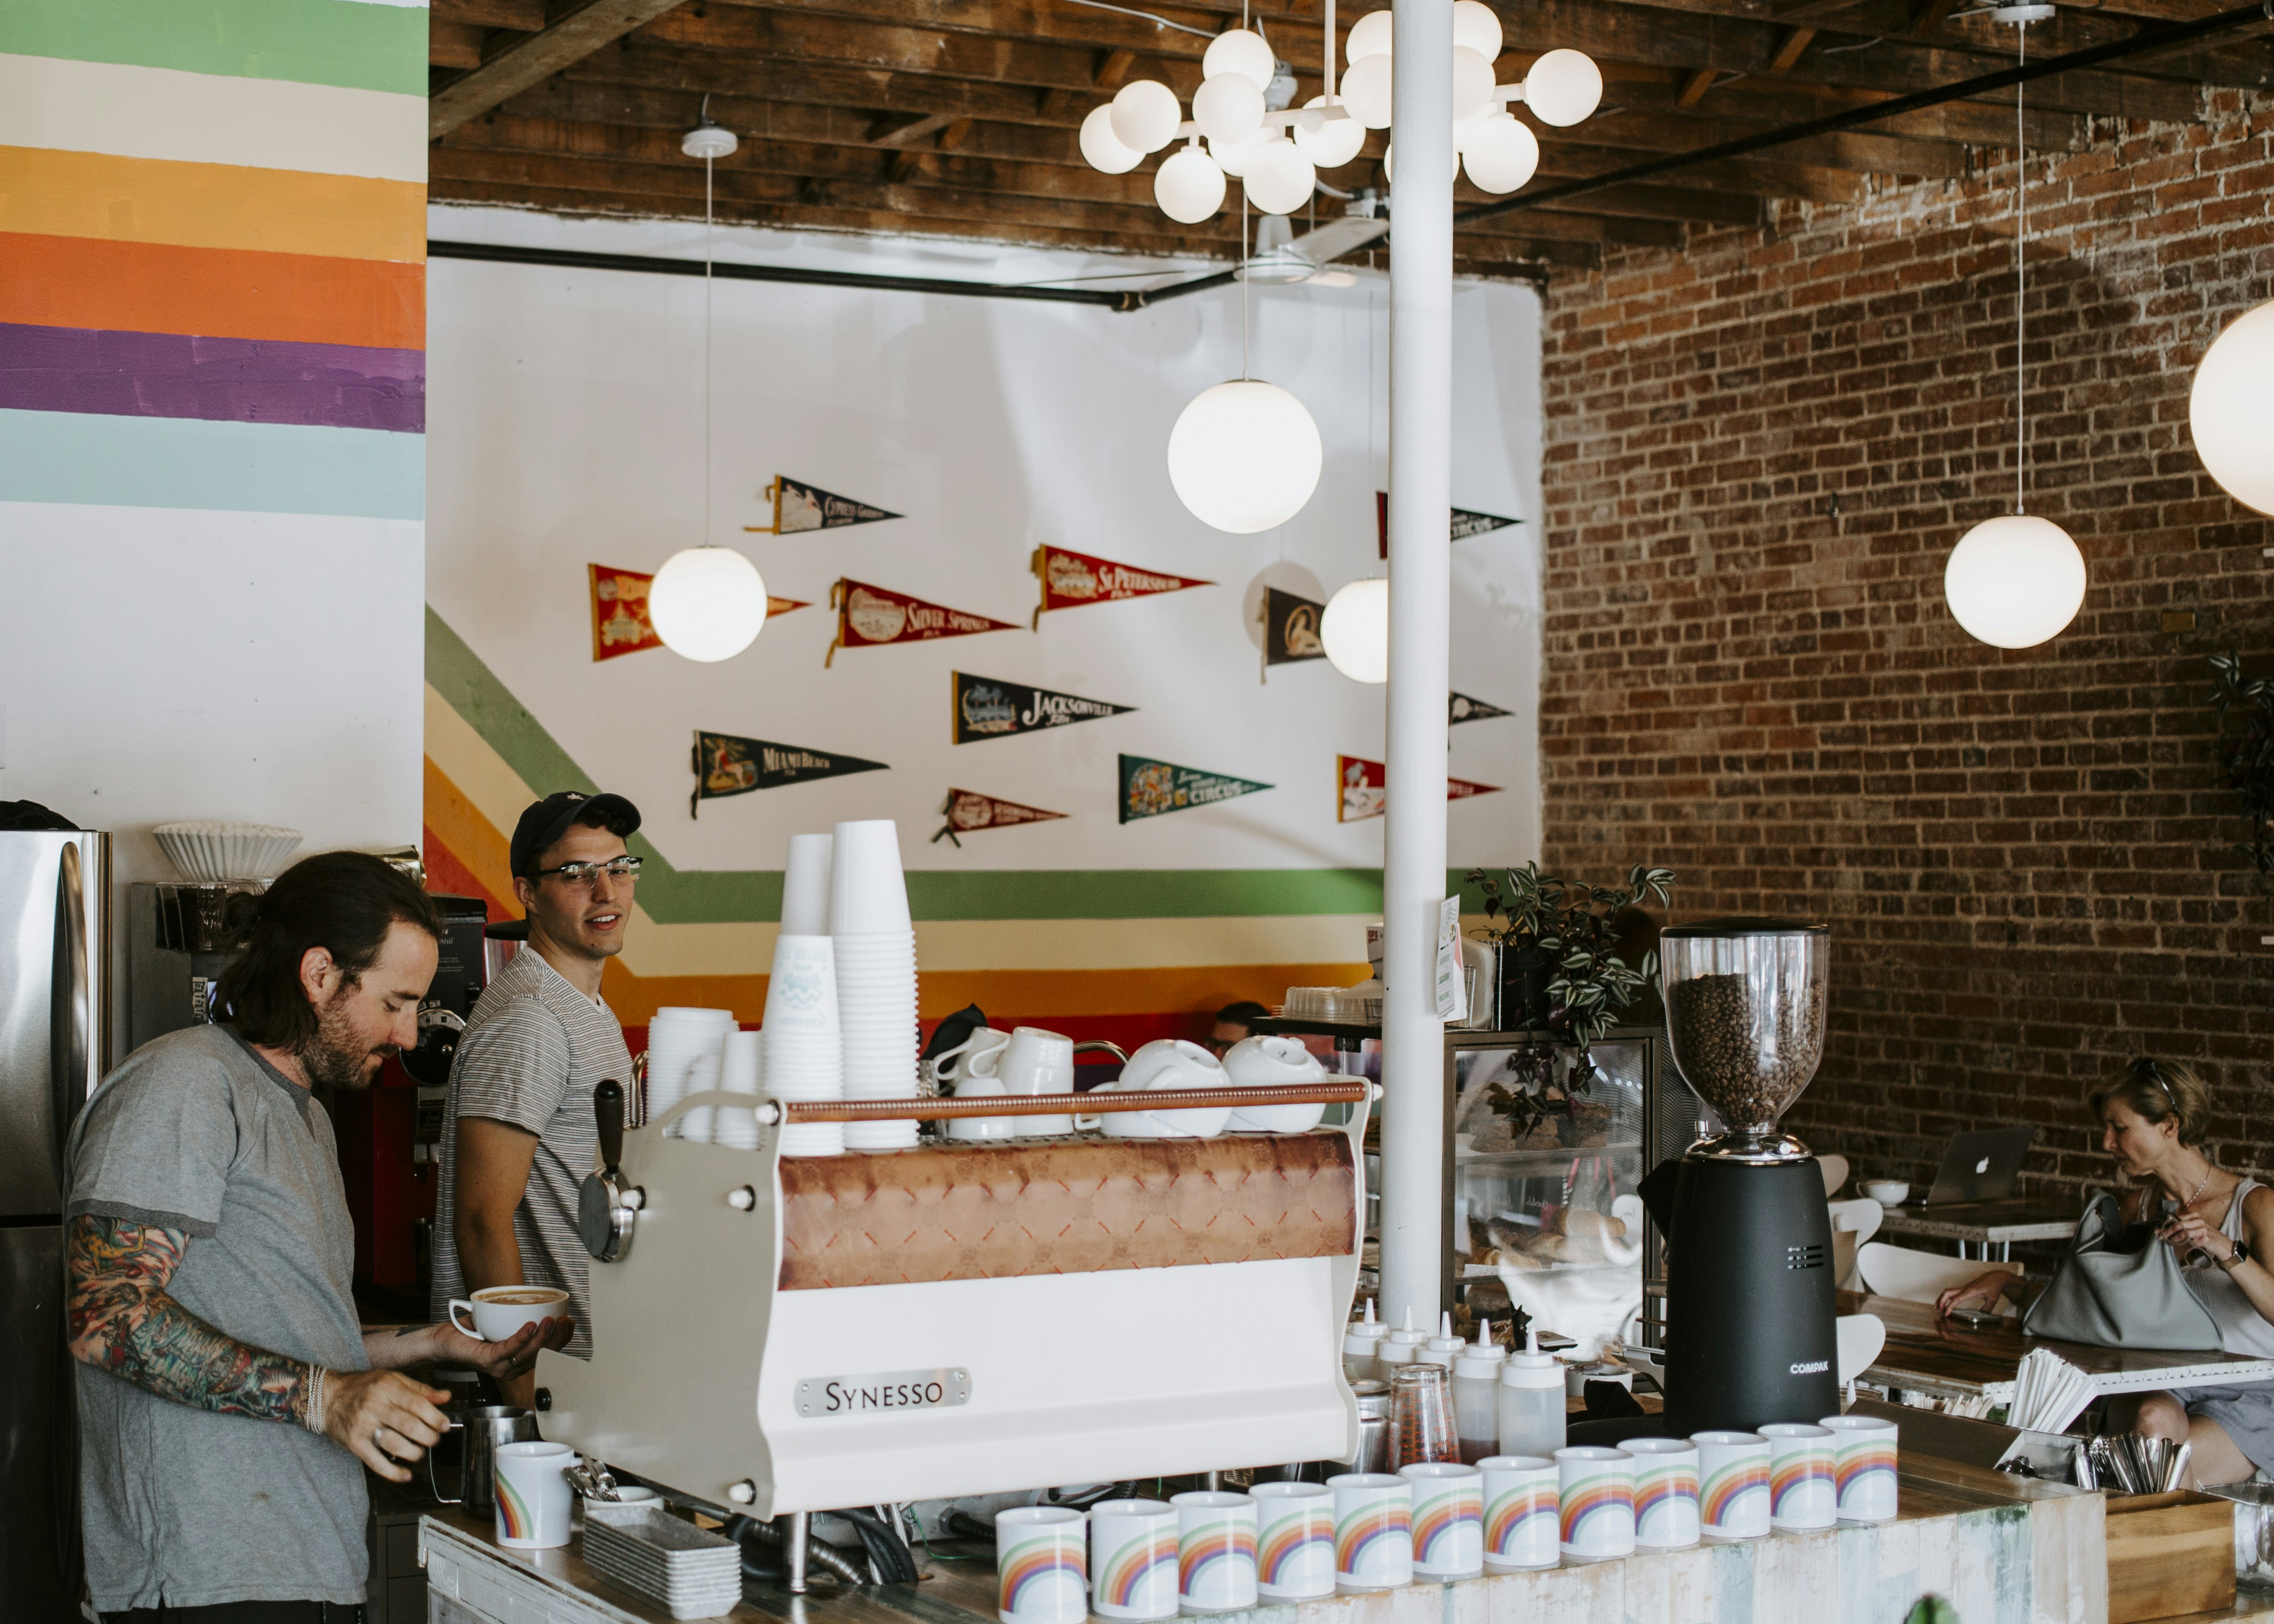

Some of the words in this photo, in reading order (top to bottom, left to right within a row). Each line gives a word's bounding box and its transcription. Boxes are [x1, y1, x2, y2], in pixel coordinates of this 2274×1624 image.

[907, 602, 945, 633] SILVER
[947, 611, 990, 632] SPRINGS
[1022, 691, 1113, 726] JACKSONVILLE
[763, 747, 801, 773] MIAMI
[802, 752, 830, 769] BEACH
[1190, 780, 1243, 804] CIRCUS
[1790, 1361, 1829, 1374] COMPAK
[826, 1382, 943, 1411] SYNESSO
